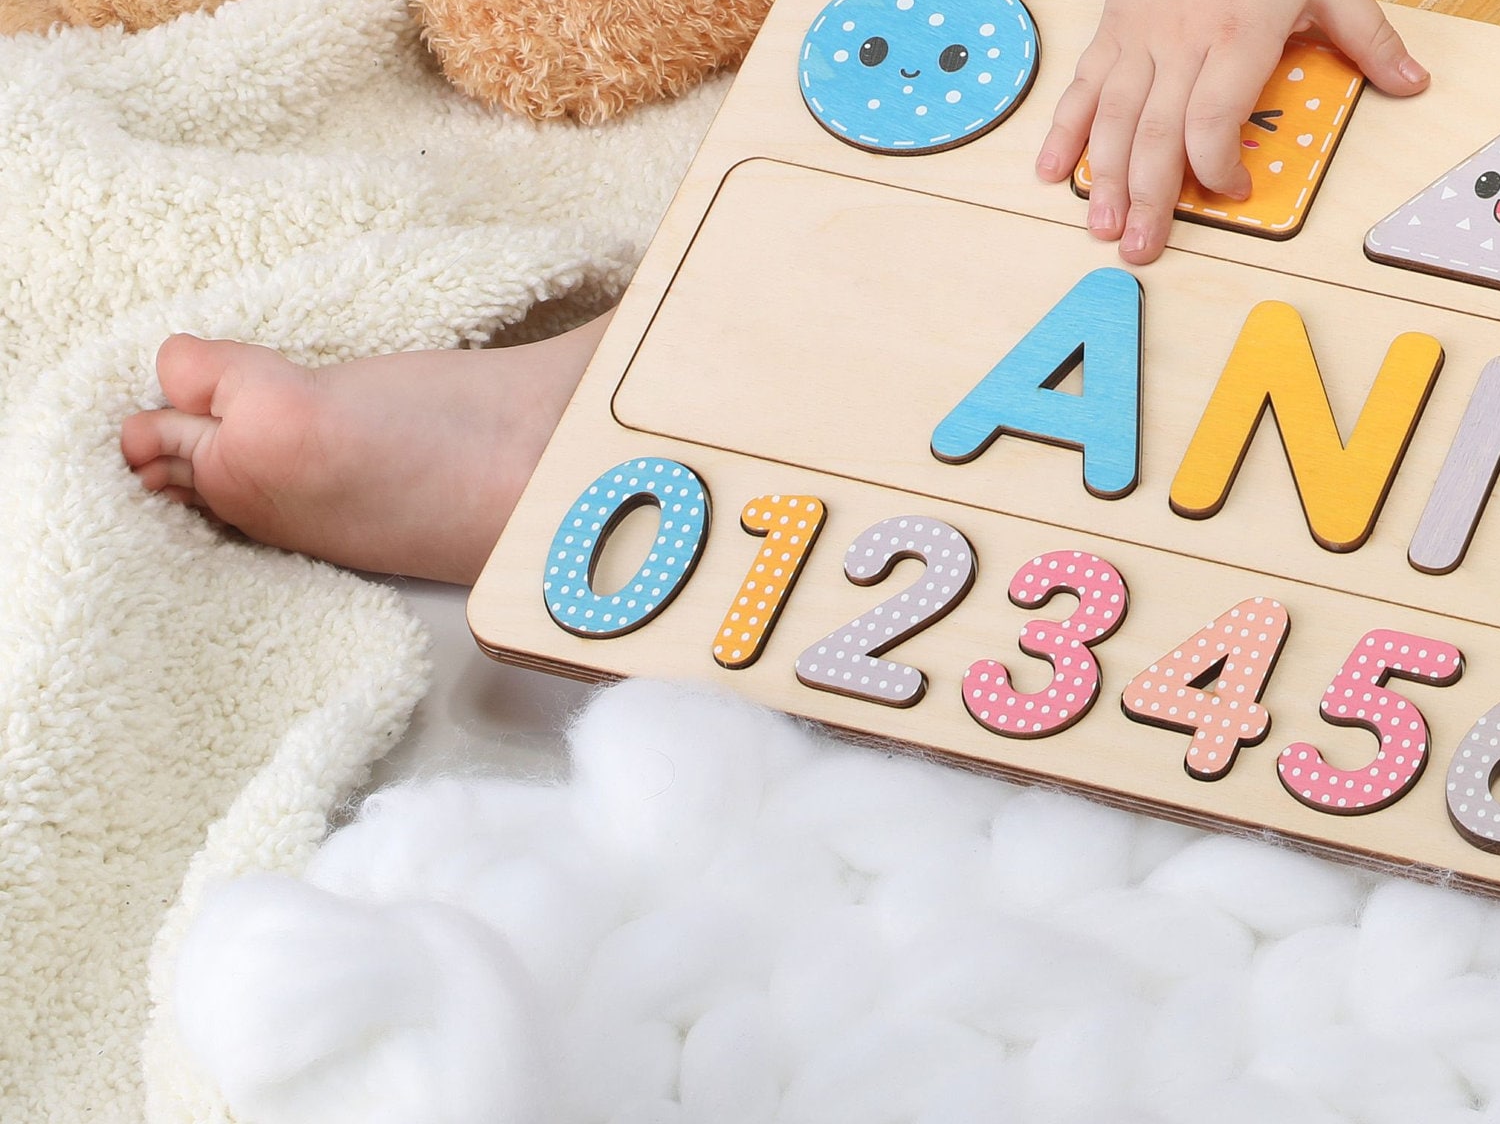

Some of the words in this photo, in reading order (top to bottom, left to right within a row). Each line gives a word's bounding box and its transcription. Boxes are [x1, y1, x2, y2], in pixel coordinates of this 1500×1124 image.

[543, 456, 712, 639] 0
[711, 494, 830, 670] 1
[794, 514, 980, 709] 2
[961, 549, 1130, 739] 3
[1121, 596, 1292, 782] 4
[1276, 627, 1465, 817] 5
